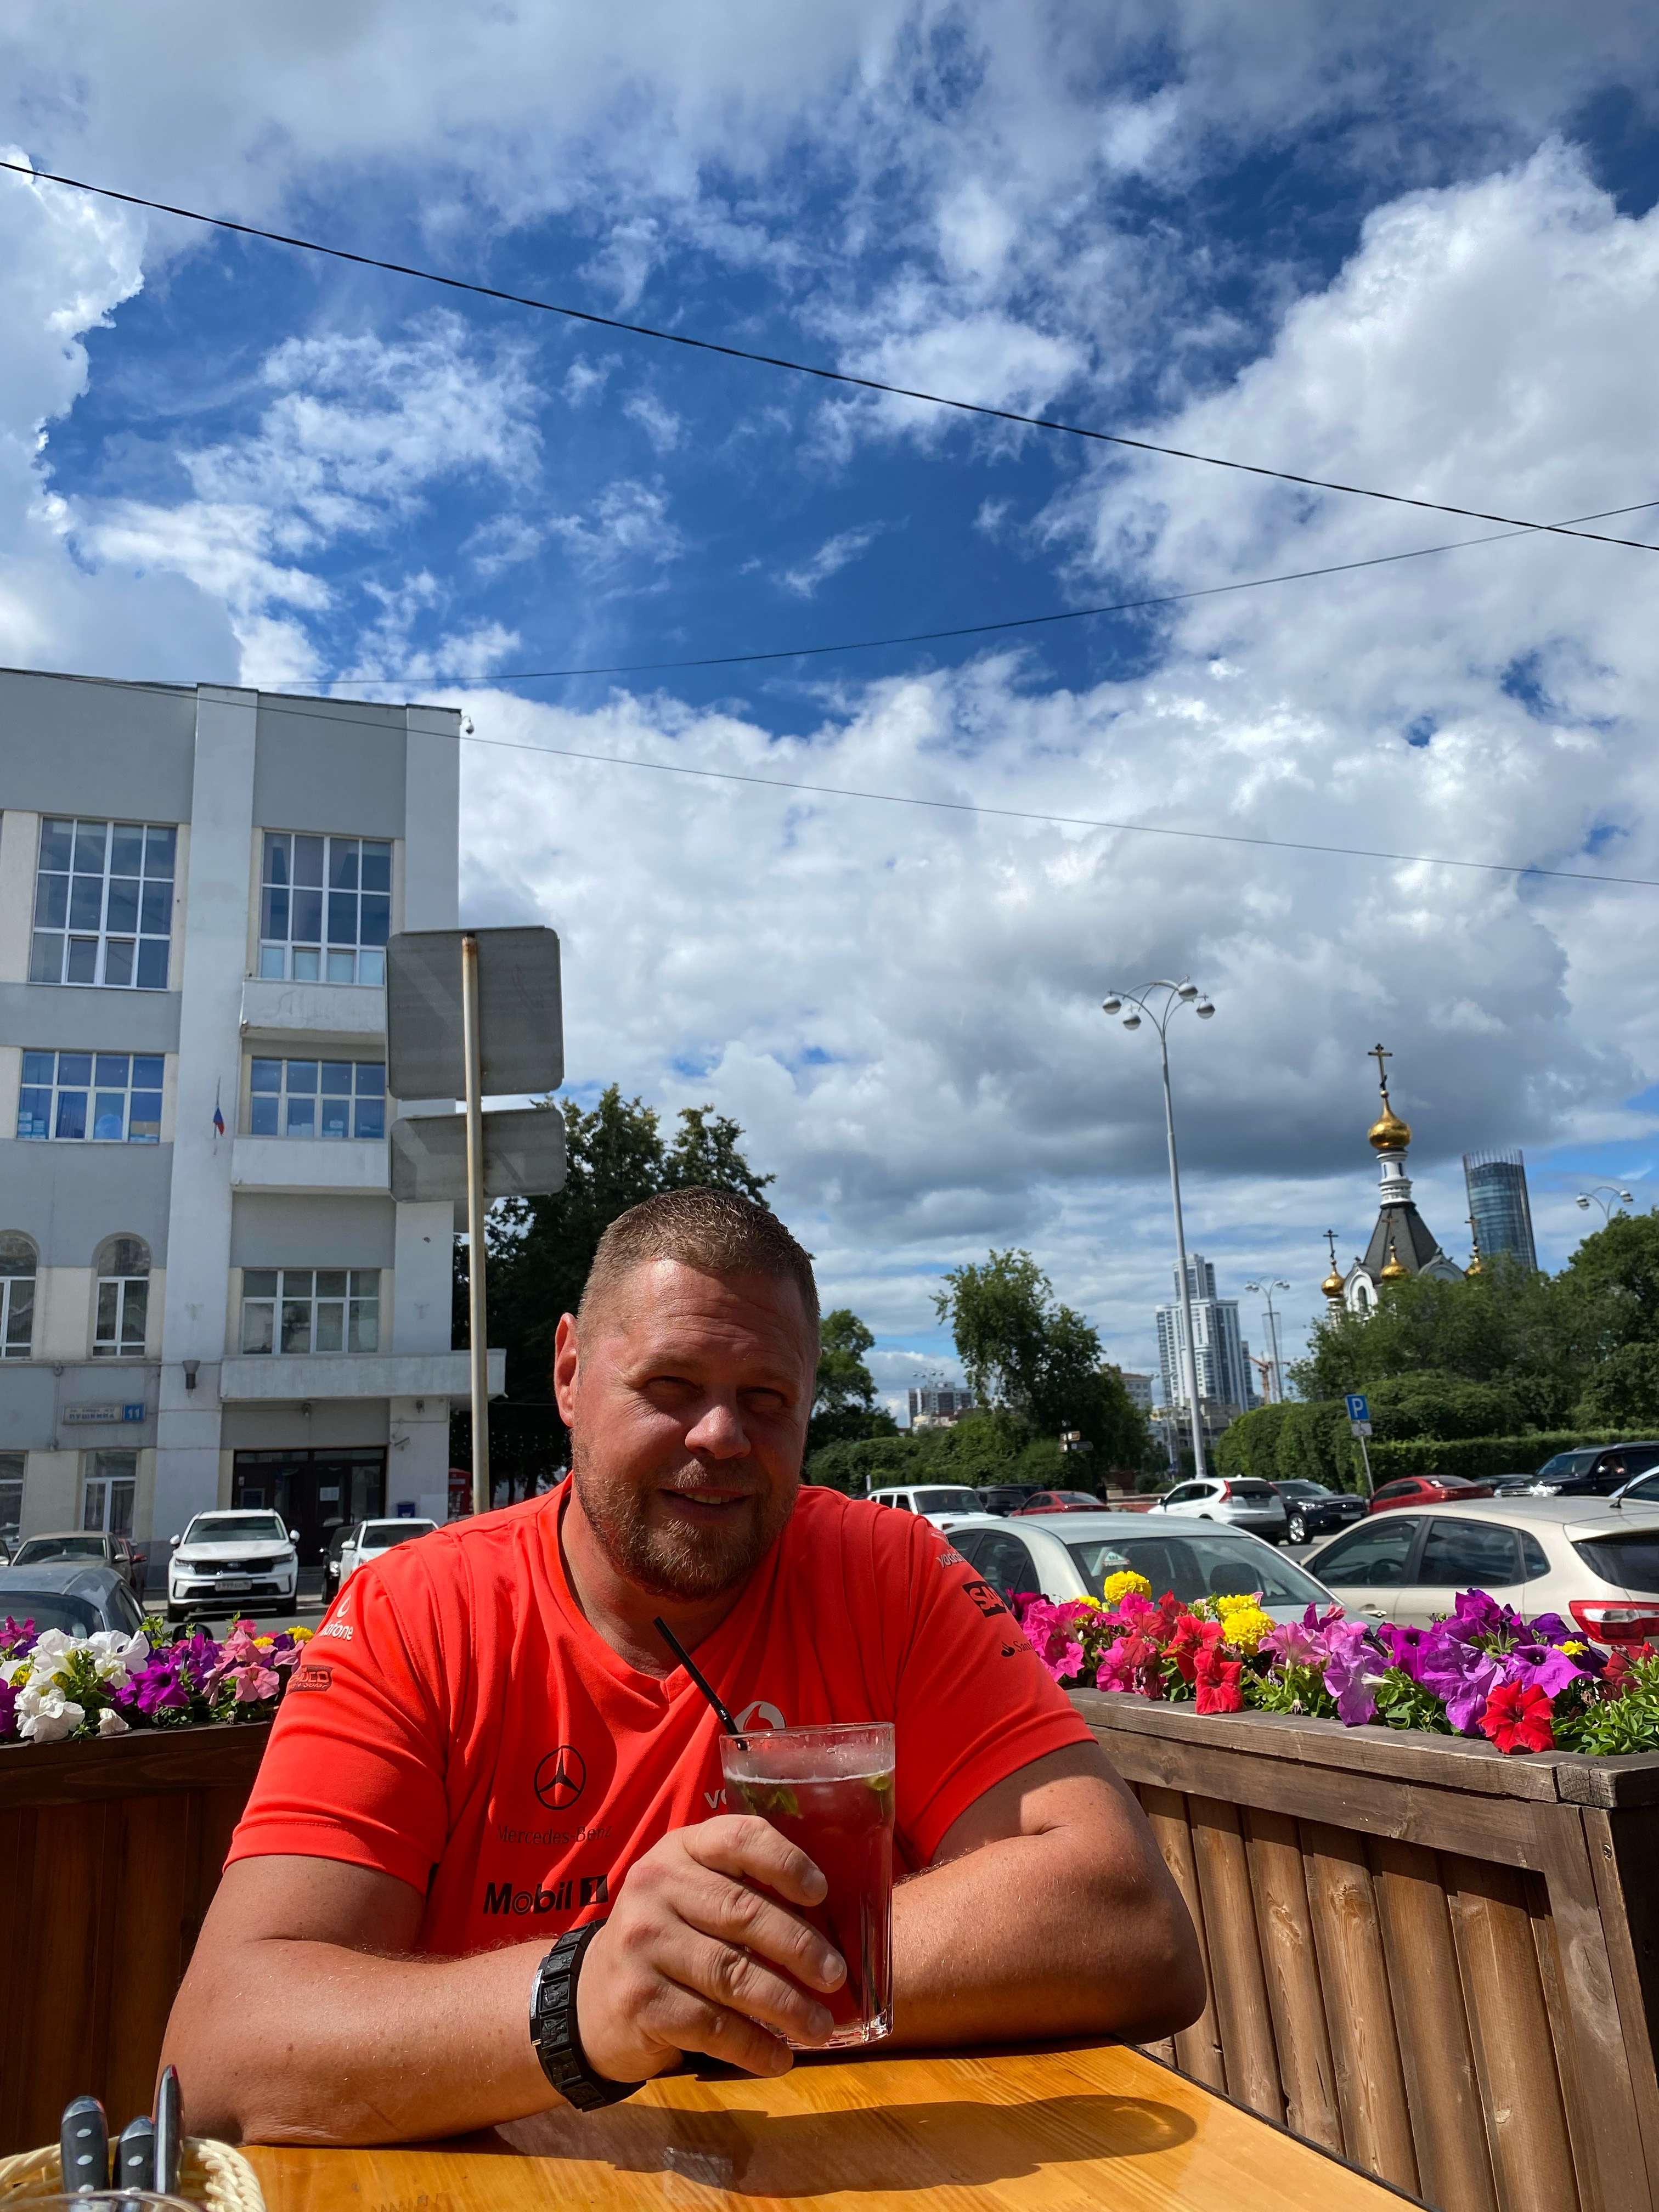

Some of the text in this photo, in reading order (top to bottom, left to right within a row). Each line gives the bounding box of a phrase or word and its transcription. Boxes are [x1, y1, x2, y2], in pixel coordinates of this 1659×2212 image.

[128, 1408, 140, 1418] 11
[1351, 1398, 1364, 1418] P
[498, 1825, 613, 1845] Mercedes-Benz
[483, 1880, 574, 1915] Mobil
